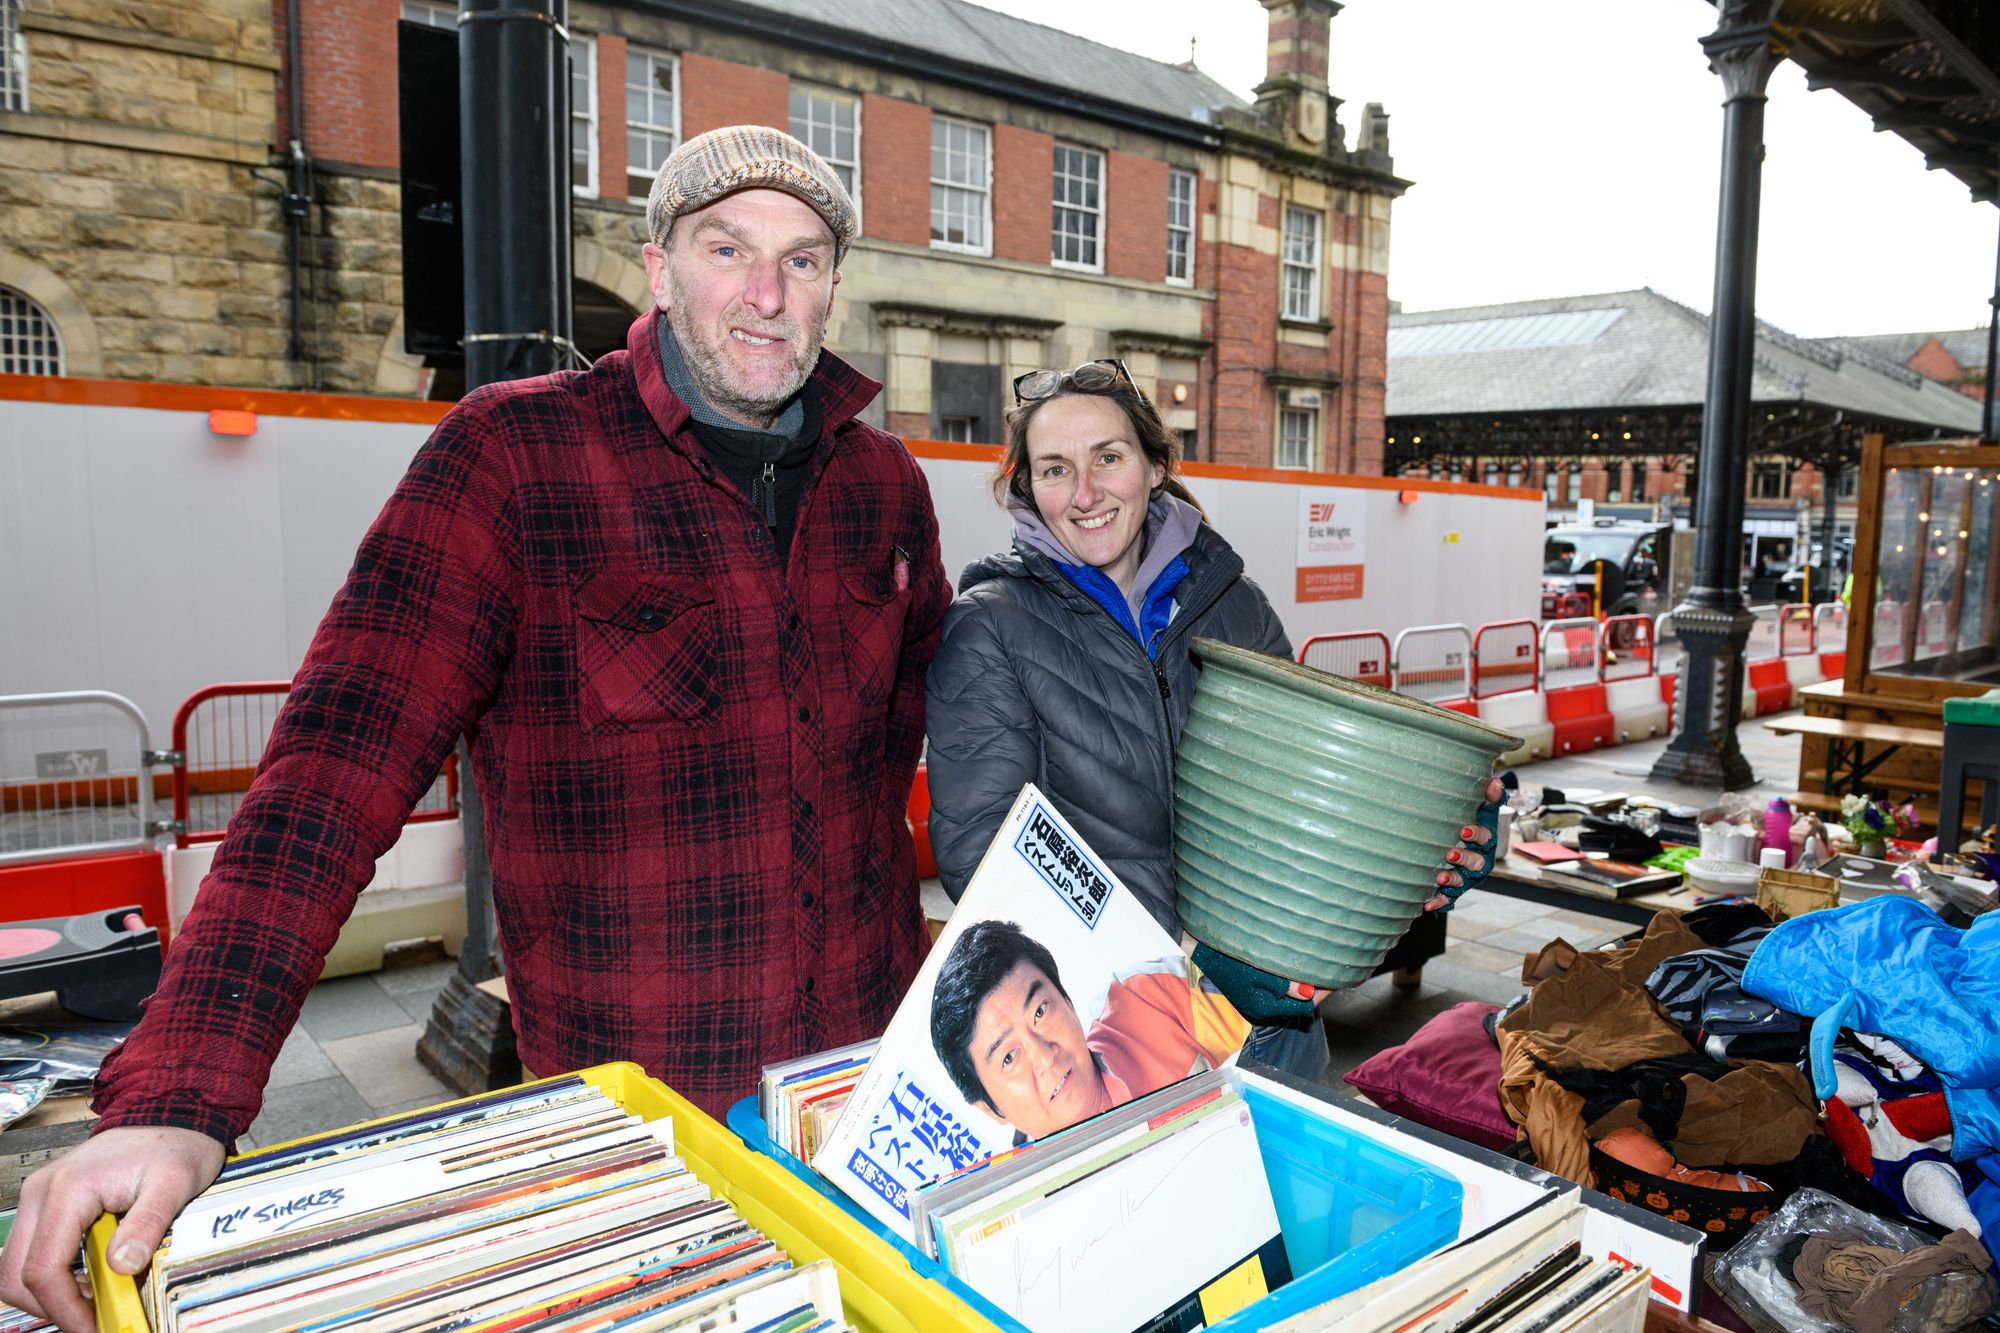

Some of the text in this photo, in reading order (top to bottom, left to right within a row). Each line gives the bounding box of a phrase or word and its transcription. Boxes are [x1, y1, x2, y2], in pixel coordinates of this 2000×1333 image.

[1309, 526, 1351, 540] Eric Wright
[1309, 541, 1355, 552] Construction
[1030, 812, 1108, 905] 石原裕次郎
[882, 1071, 992, 1171] 石原裕
[253, 1188, 345, 1223] SINGLES
